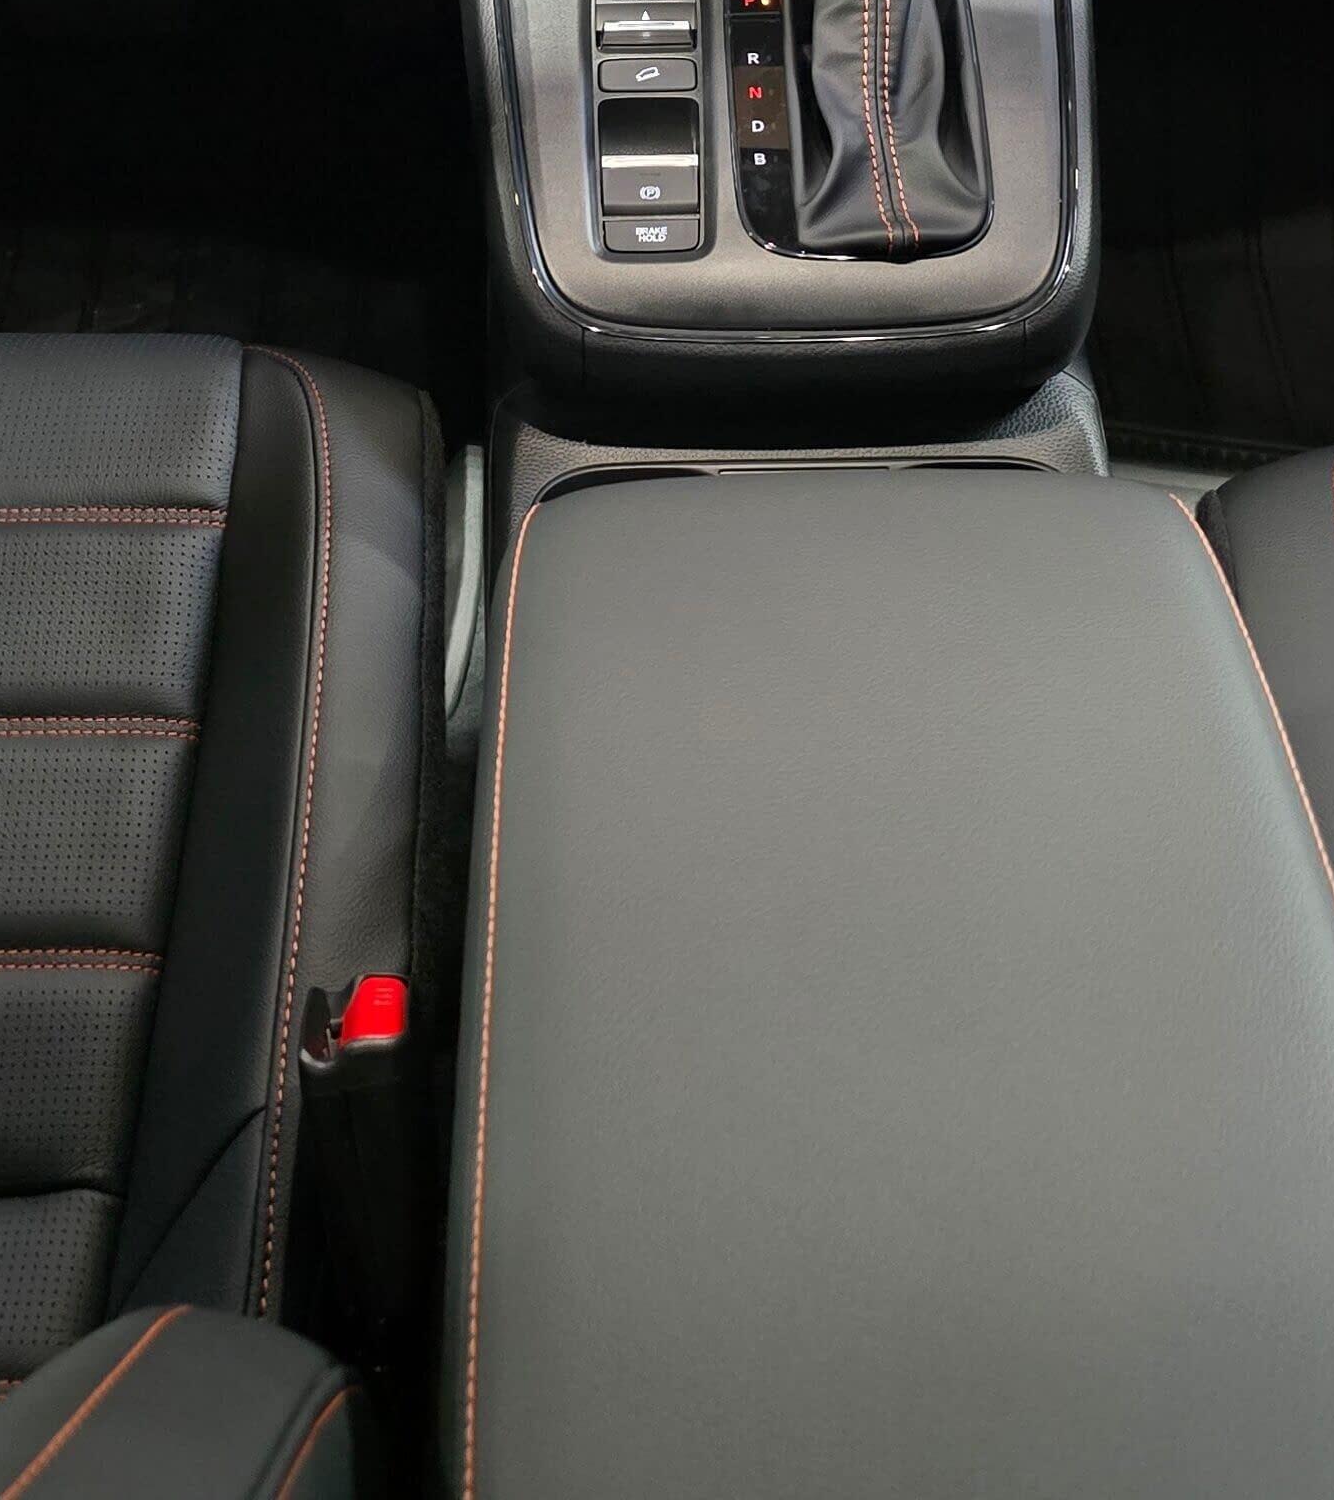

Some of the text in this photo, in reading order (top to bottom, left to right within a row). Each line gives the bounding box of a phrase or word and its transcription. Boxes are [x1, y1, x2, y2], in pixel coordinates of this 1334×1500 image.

[747, 52, 760, 65] R
[749, 86, 762, 99] N
[751, 120, 765, 133] D
[754, 152, 766, 166] B
[635, 226, 668, 236] BRAKE
[638, 235, 667, 243] HOLD
